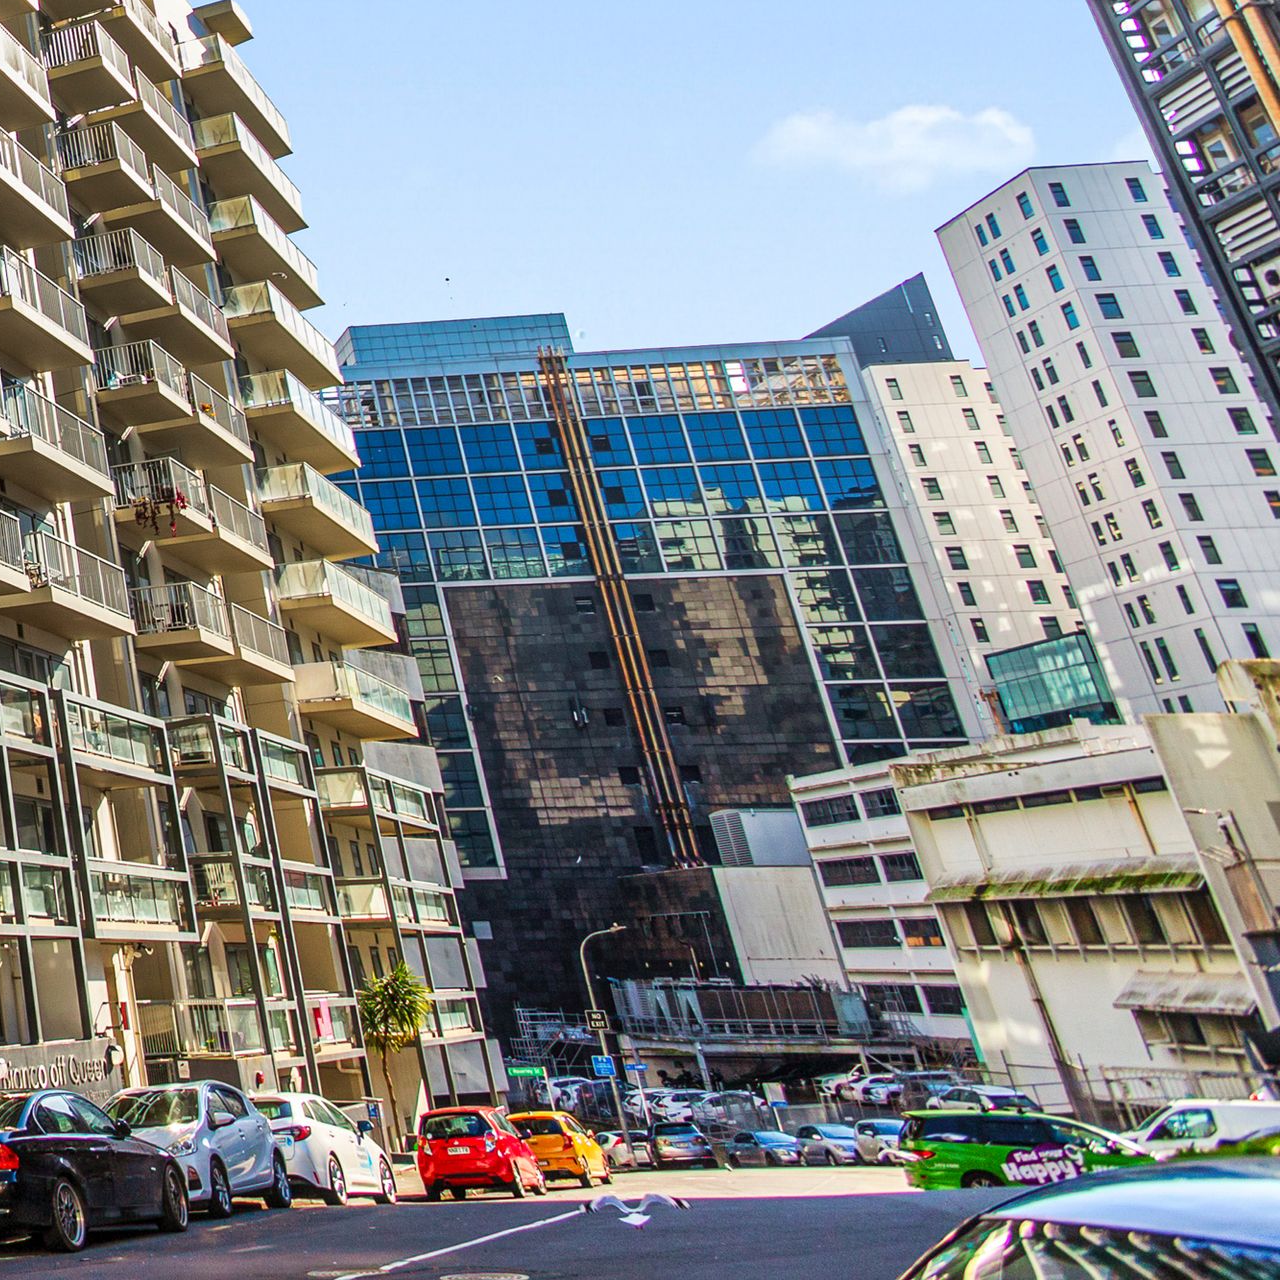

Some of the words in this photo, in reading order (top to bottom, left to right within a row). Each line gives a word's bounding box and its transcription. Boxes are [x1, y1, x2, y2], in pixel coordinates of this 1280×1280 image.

[591, 1020, 605, 1028] EXIT
[49, 1054, 67, 1087] off
[68, 1053, 109, 1086] Queen
[1013, 1150, 1038, 1163] Find
